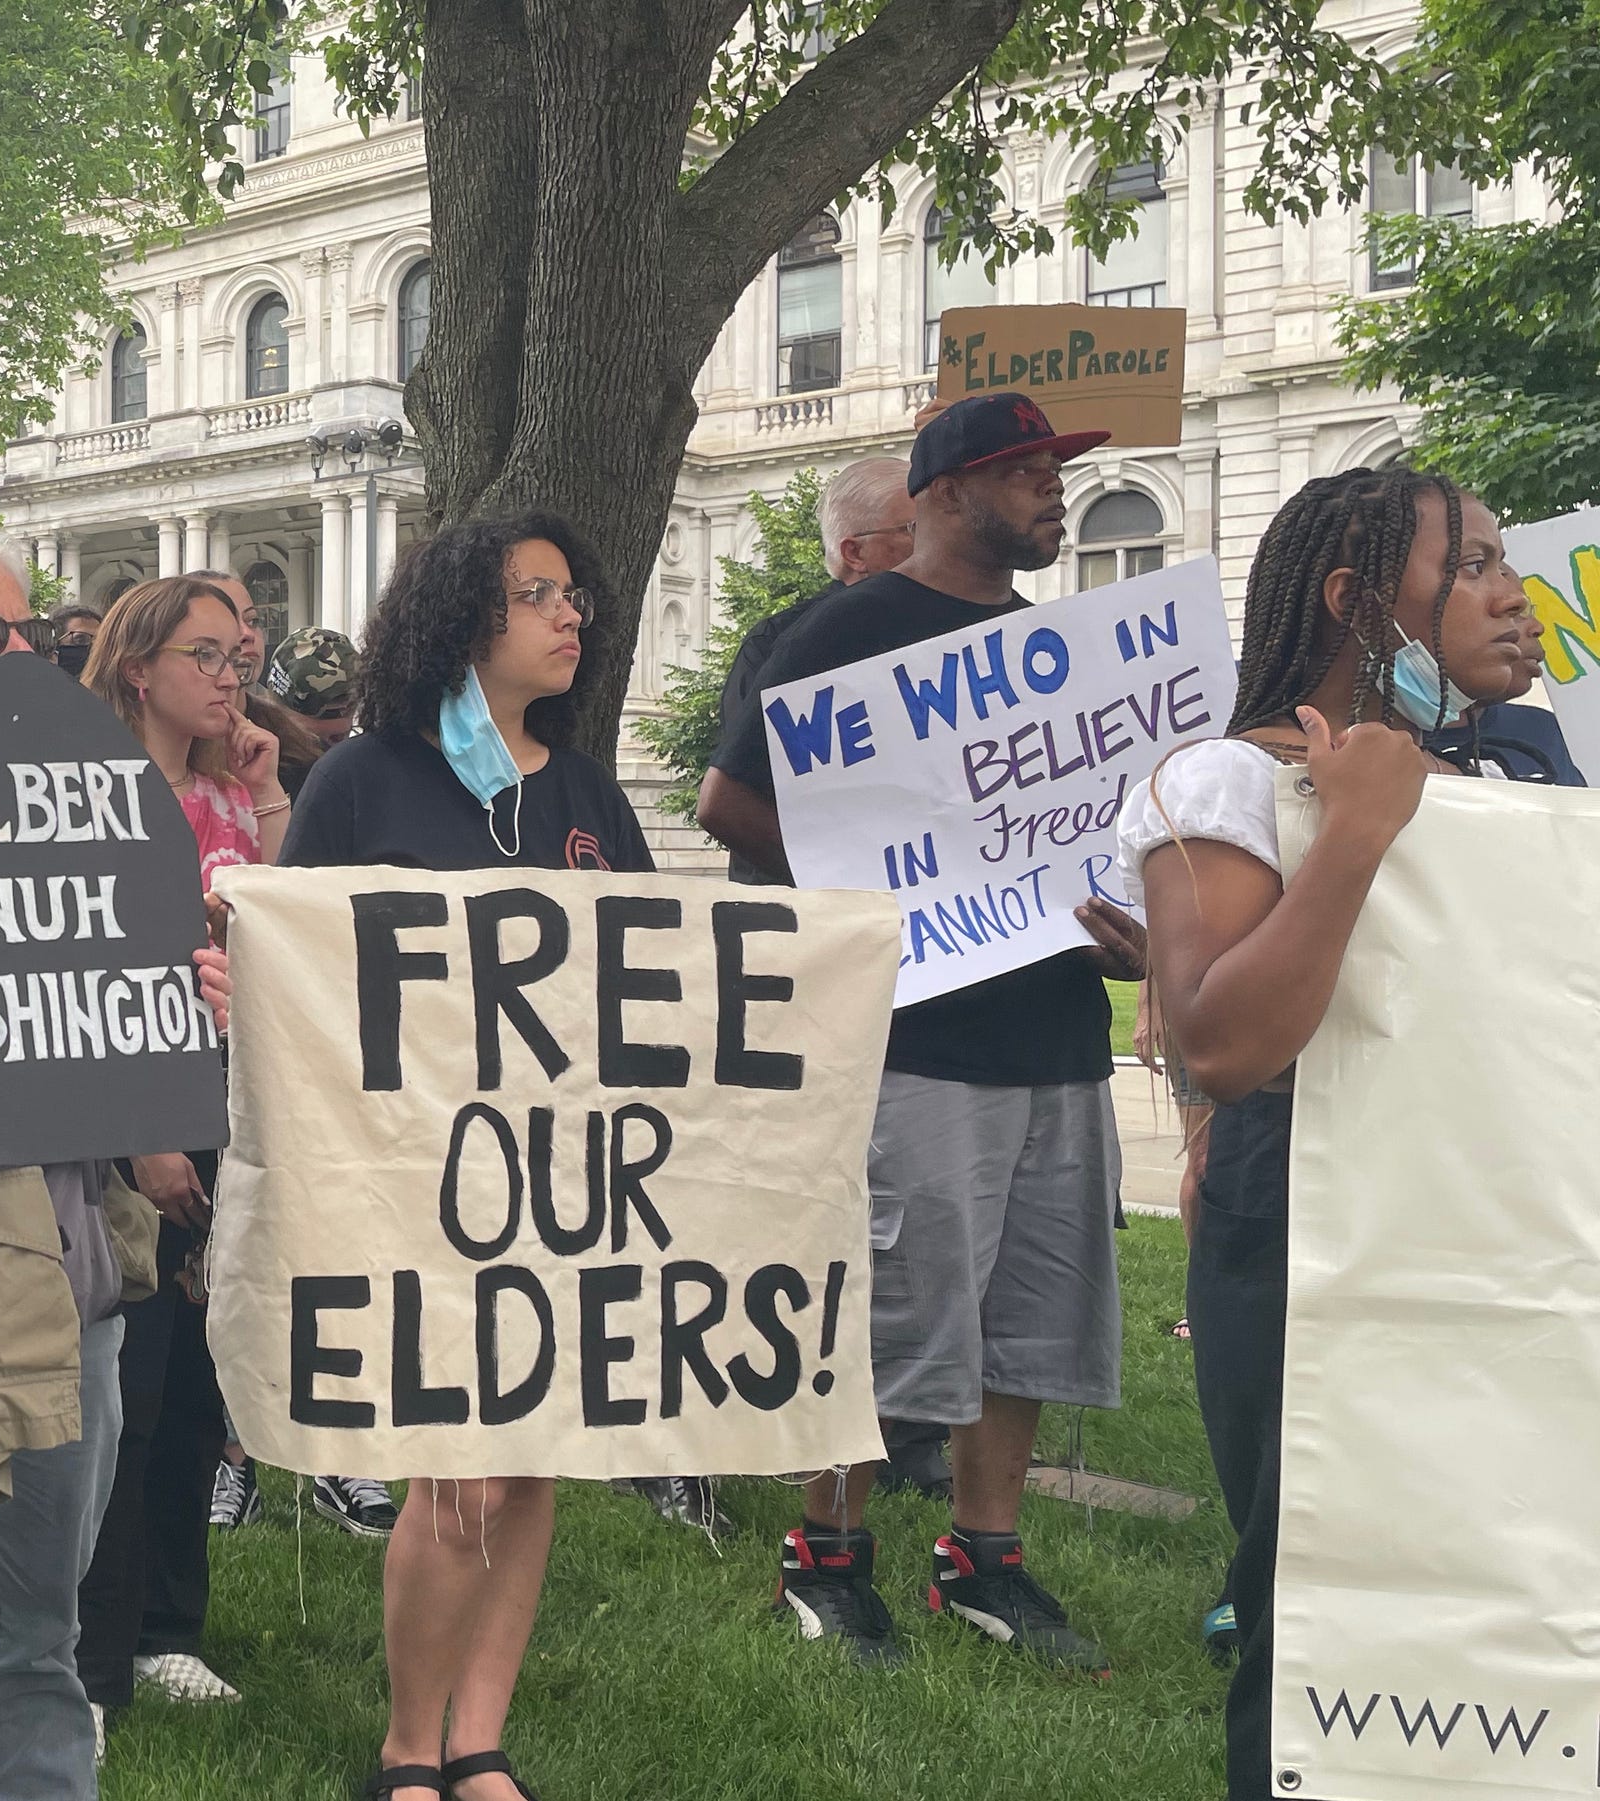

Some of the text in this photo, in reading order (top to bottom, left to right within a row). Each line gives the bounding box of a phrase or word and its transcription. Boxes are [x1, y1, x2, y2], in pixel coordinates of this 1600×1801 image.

[765, 601, 1178, 776] WE WHO IN
[962, 666, 1211, 802] BELIEVE
[884, 832, 939, 889] IN
[899, 864, 1050, 967] ANNOT
[350, 887, 804, 1091] FREE
[439, 1102, 673, 1261] OUR
[290, 1260, 847, 1429] ELDERS!
